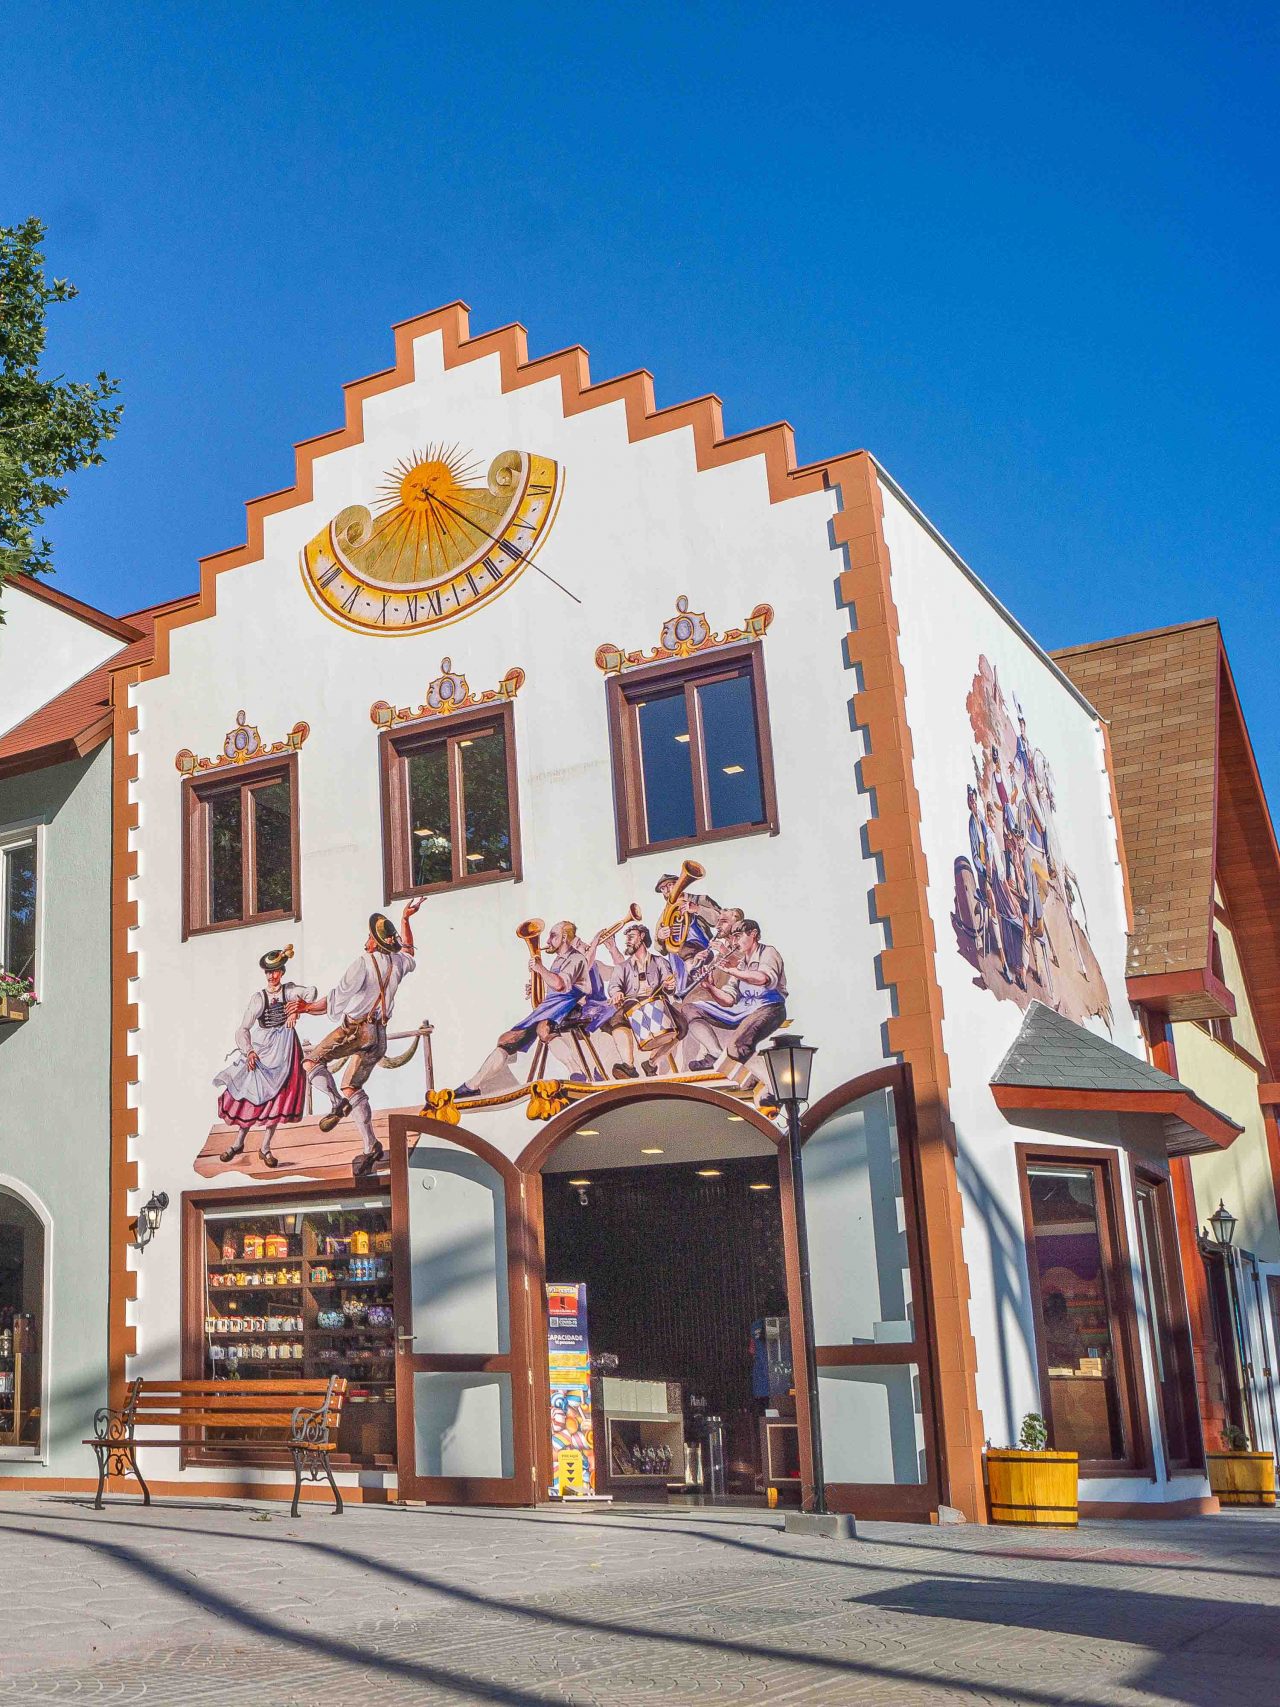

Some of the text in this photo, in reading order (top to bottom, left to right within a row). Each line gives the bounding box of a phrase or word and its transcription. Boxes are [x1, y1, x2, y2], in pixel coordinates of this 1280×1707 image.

[340, 585, 365, 613] IX
[374, 594, 392, 625] X
[402, 594, 418, 625] XI
[451, 583, 461, 607] I
[465, 571, 480, 597] II
[481, 556, 504, 583] III
[512, 516, 537, 531] V
